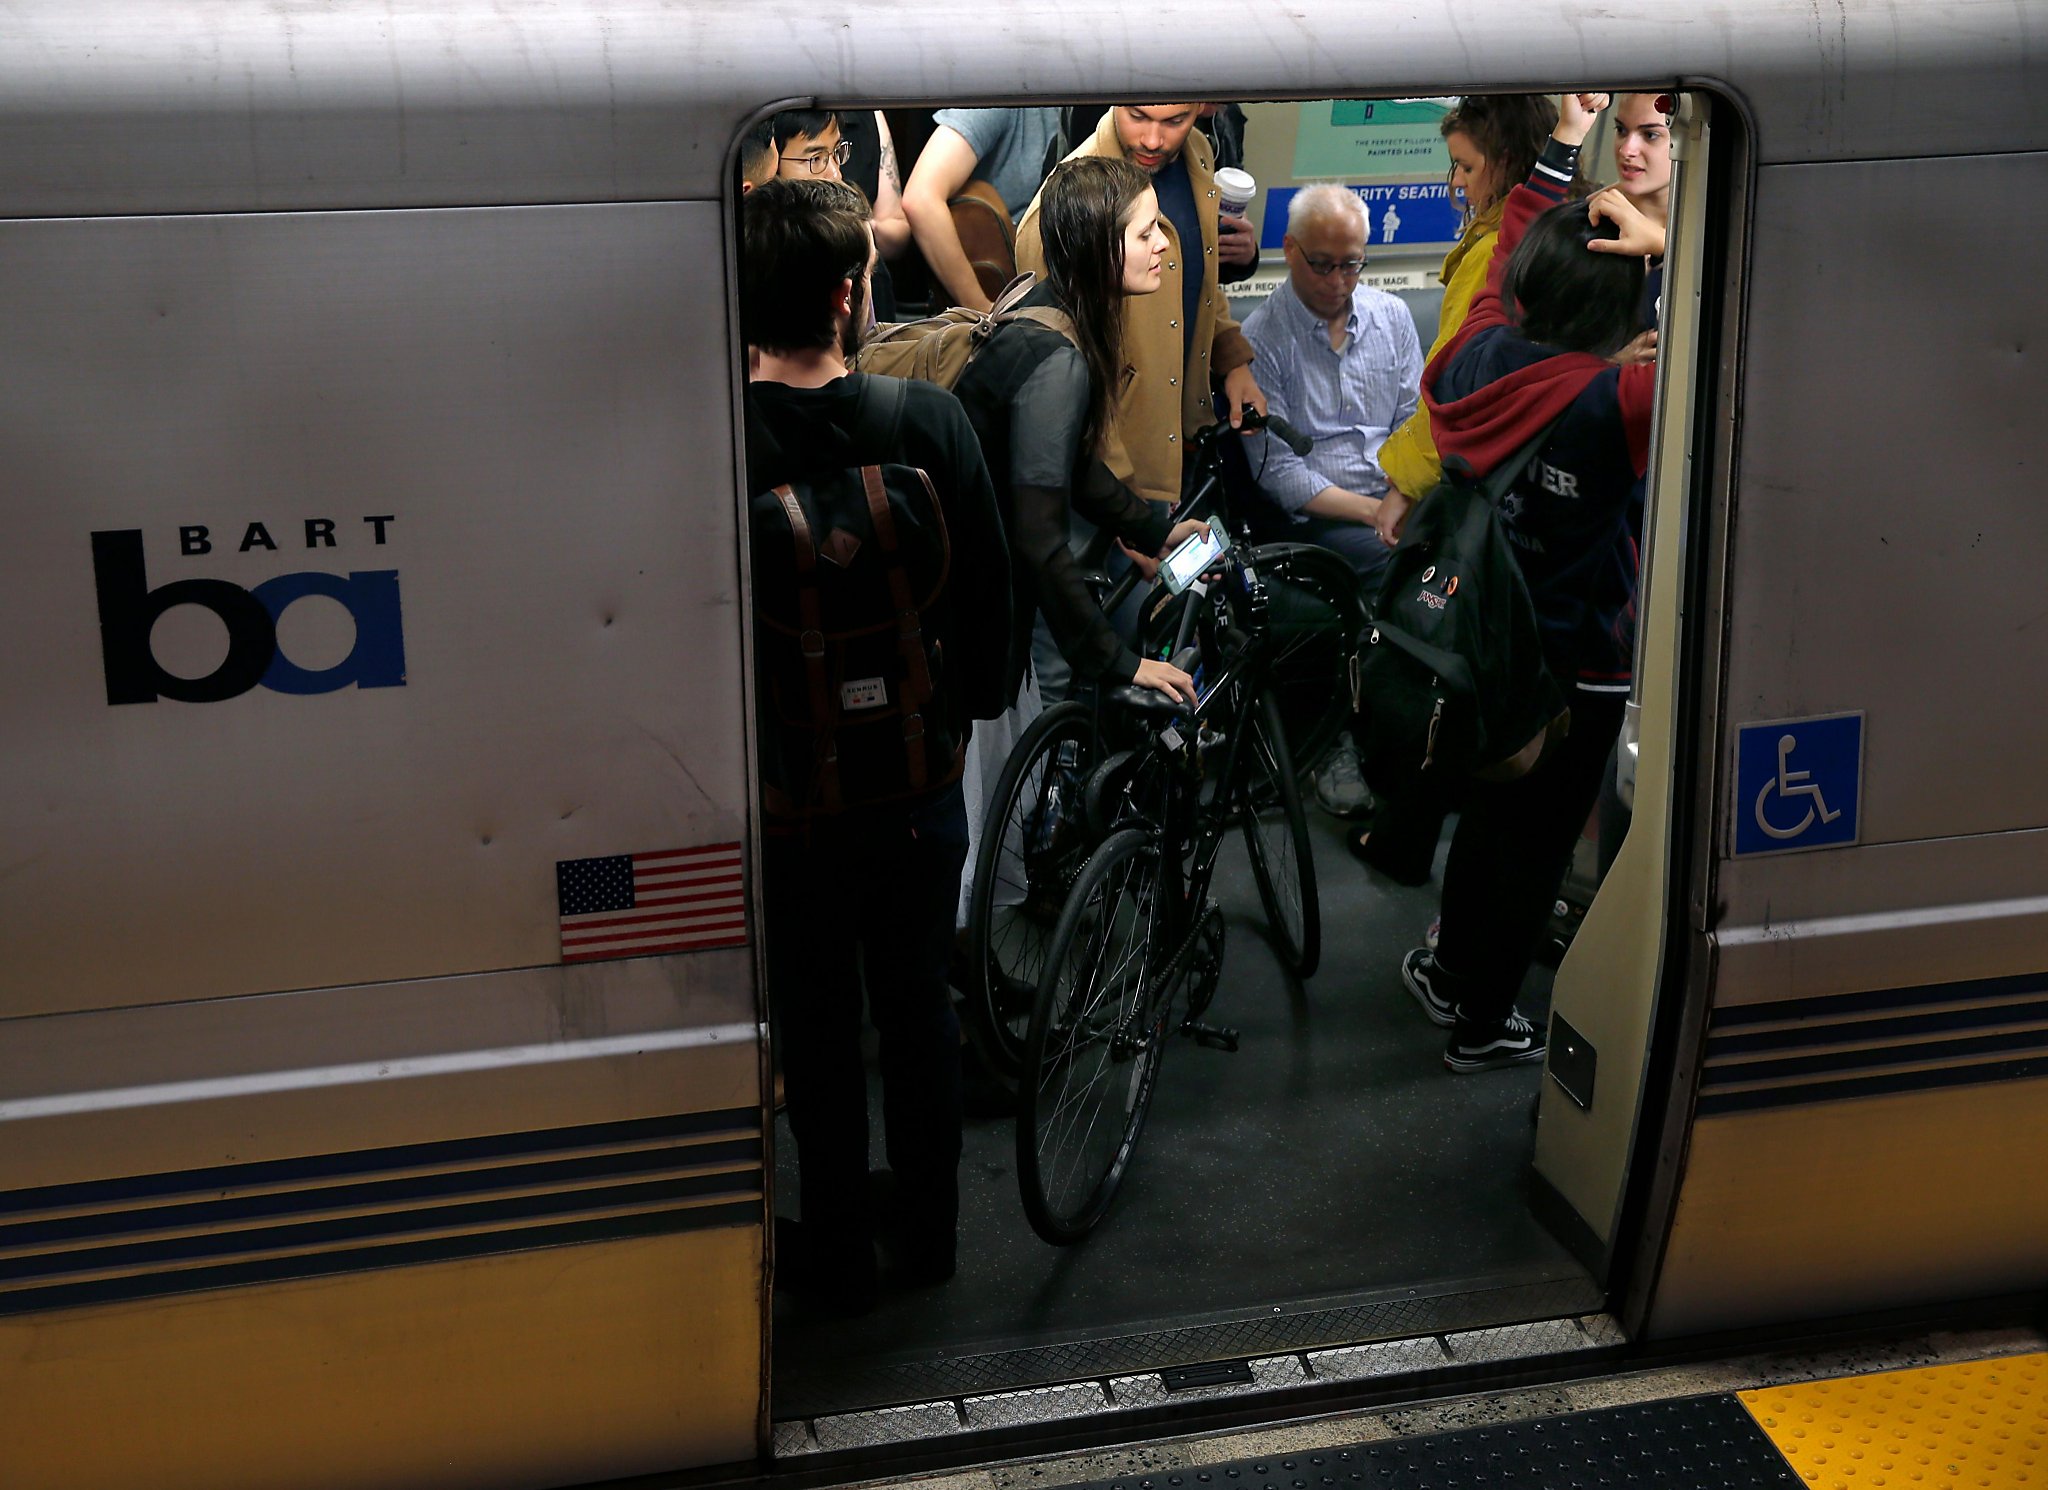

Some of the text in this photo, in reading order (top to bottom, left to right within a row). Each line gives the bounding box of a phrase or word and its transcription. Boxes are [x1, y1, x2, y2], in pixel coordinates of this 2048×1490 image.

[1404, 137, 1431, 145] PILLOW
[1404, 147, 1432, 155] LADIES
[1232, 283, 1251, 292] LAW
[1367, 277, 1379, 286] BE
[1383, 276, 1409, 285] MADE
[179, 515, 395, 556] BART
